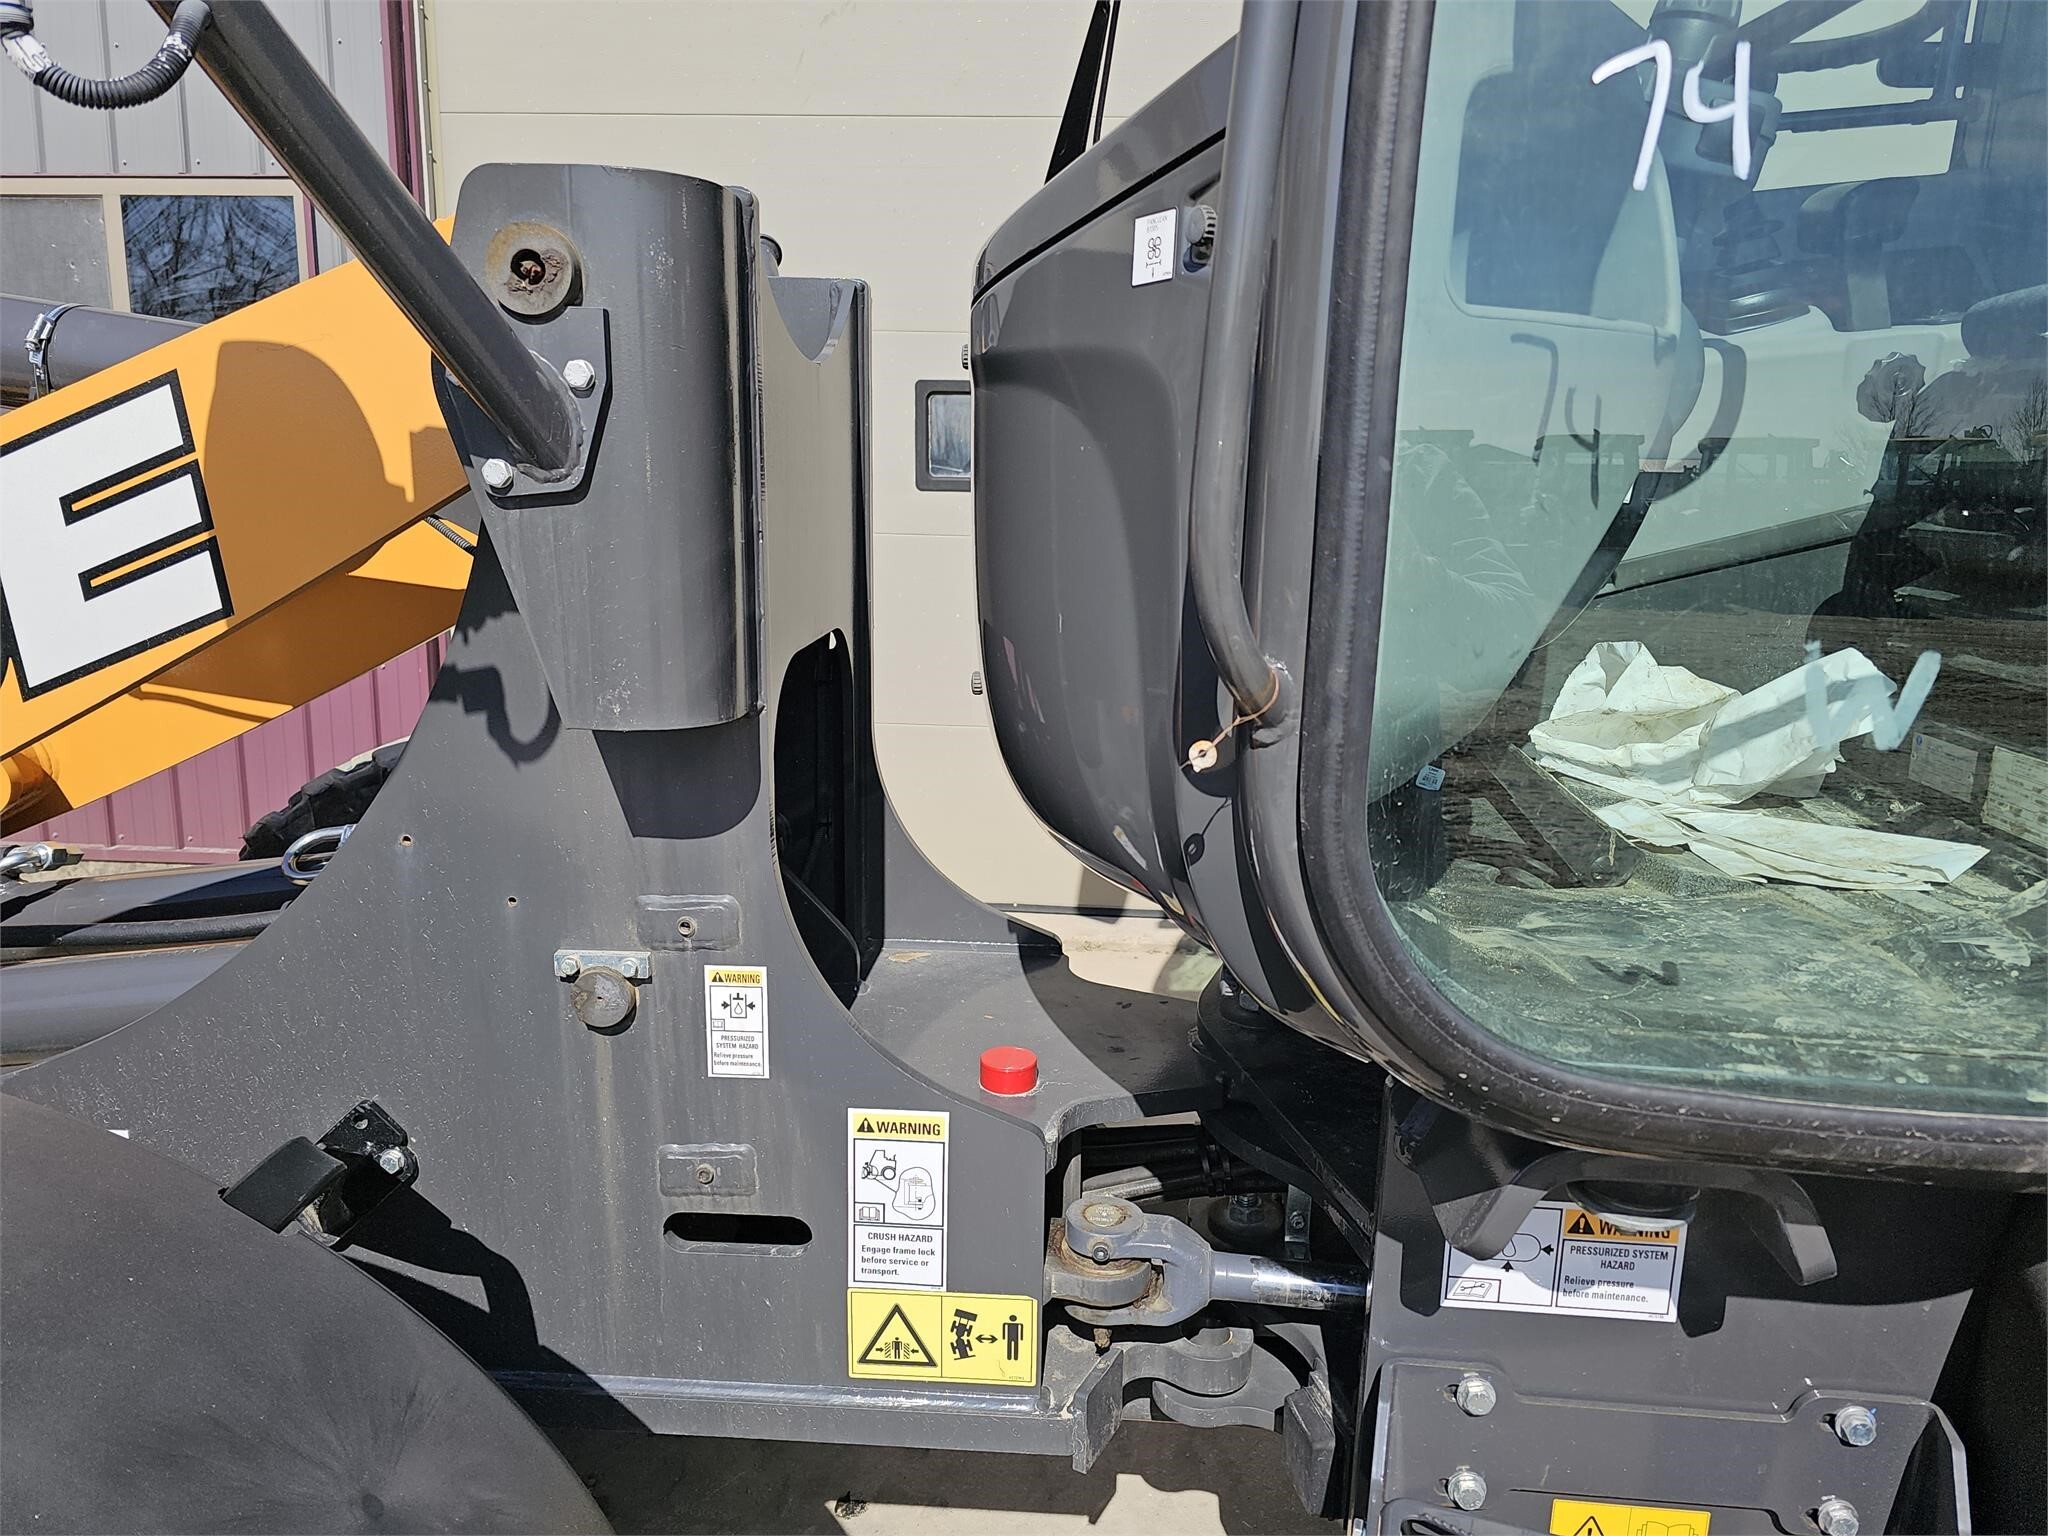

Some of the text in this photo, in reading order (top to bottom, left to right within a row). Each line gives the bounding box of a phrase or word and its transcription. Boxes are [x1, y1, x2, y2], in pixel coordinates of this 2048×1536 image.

[1591, 39, 1751, 191] 74
[724, 973, 761, 984] WARNING
[876, 1121, 941, 1136] WARNING
[867, 1232, 933, 1243] CRUSH HAZARD
[861, 1244, 936, 1256] Engage frame lock
[1569, 1245, 1669, 1261] PRESSURIZED SYSTEM
[861, 1256, 887, 1264] before
[889, 1258, 919, 1266] service
[1600, 1260, 1636, 1271] HAZARD
[861, 1267, 899, 1276] transport.
[1564, 1275, 1635, 1289] Relieve pressure
[1562, 1287, 1649, 1304] before maintenance.
